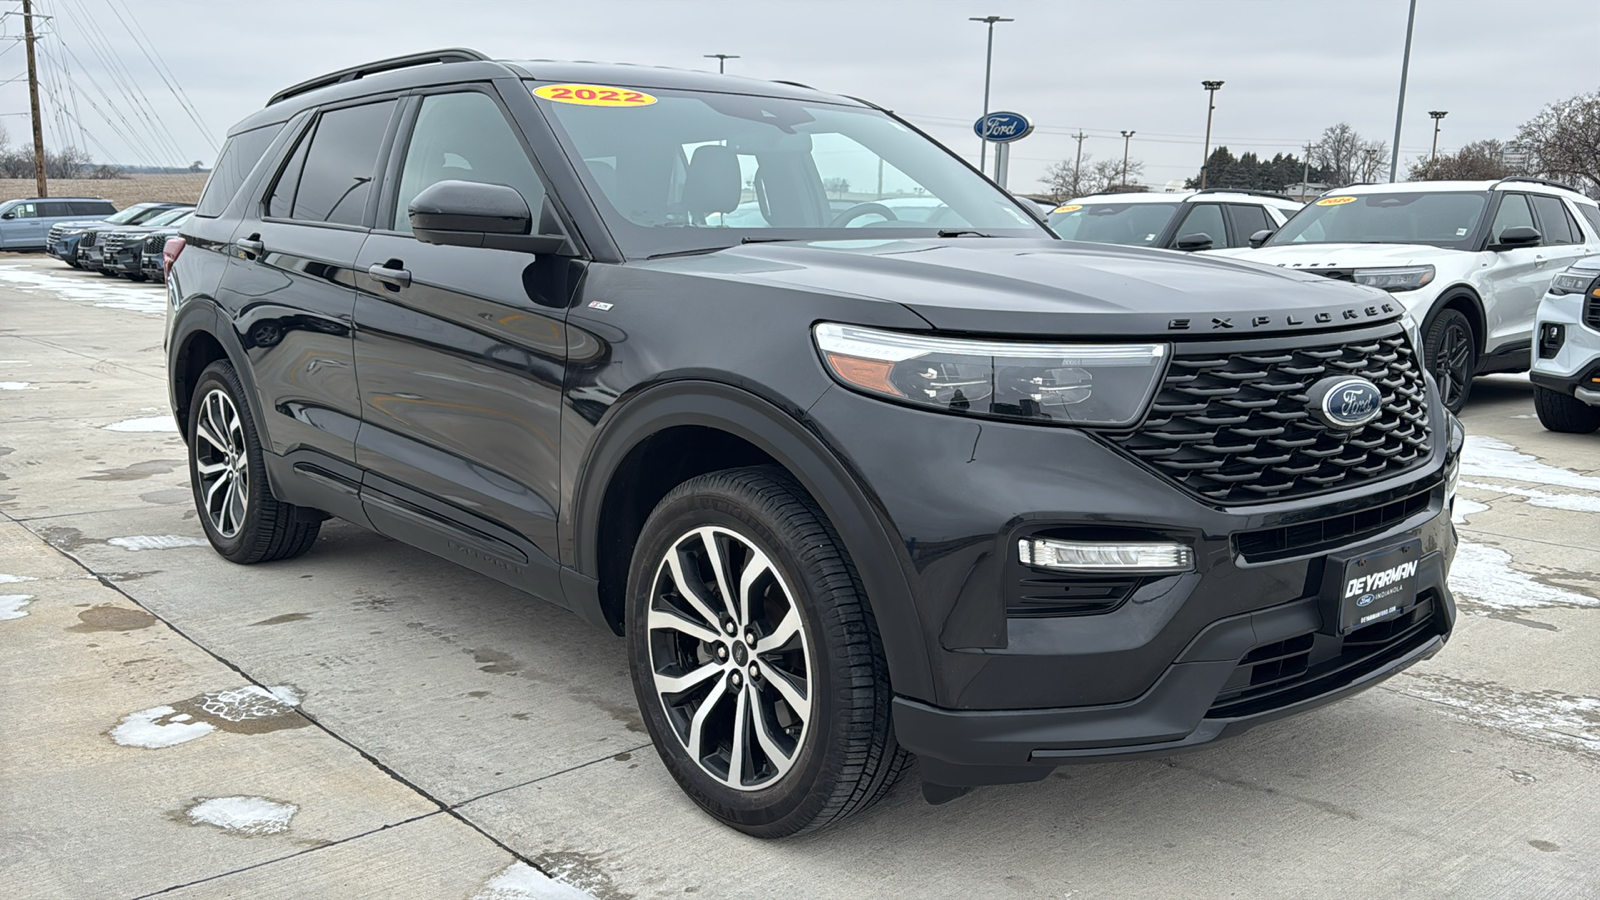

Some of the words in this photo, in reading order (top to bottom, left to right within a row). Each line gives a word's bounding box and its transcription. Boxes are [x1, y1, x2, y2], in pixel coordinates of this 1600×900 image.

[550, 87, 646, 103] 2022
[985, 117, 1018, 136] Ford
[1168, 302, 1395, 331] EXPLORER
[1341, 389, 1373, 416] Ford
[1345, 560, 1418, 598] DEYARMAN
[1375, 585, 1403, 600] INDIANOLA
